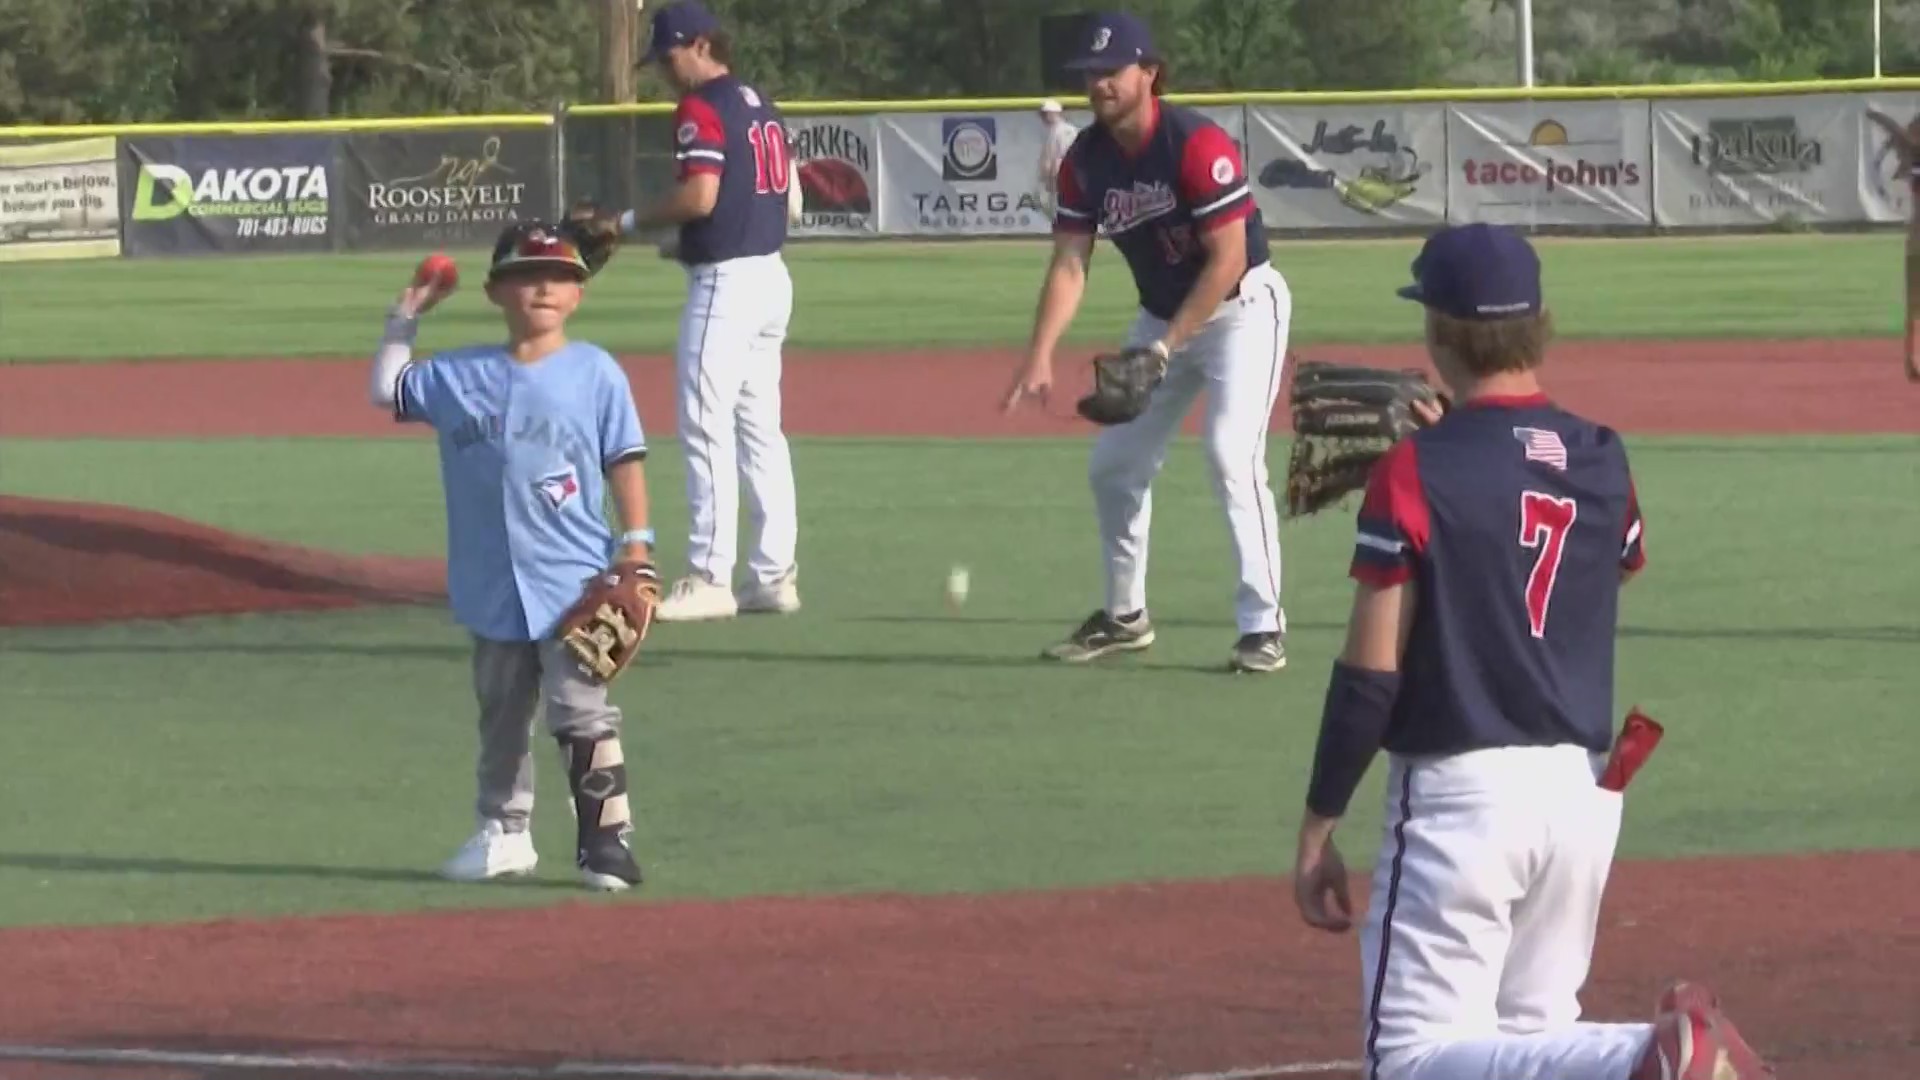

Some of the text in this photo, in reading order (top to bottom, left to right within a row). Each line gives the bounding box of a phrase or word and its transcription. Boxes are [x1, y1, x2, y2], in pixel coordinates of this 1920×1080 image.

[748, 121, 789, 194] 10
[796, 124, 869, 172] AKKEN
[132, 164, 329, 220] DAKOTA
[1463, 158, 1640, 193] taco john's
[368, 183, 525, 209] ROOSEVELT
[913, 192, 1037, 212] TARGA
[374, 208, 518, 225] GRAND DAKOTA
[800, 213, 869, 229] UPPLY
[1519, 490, 1577, 638] 7
